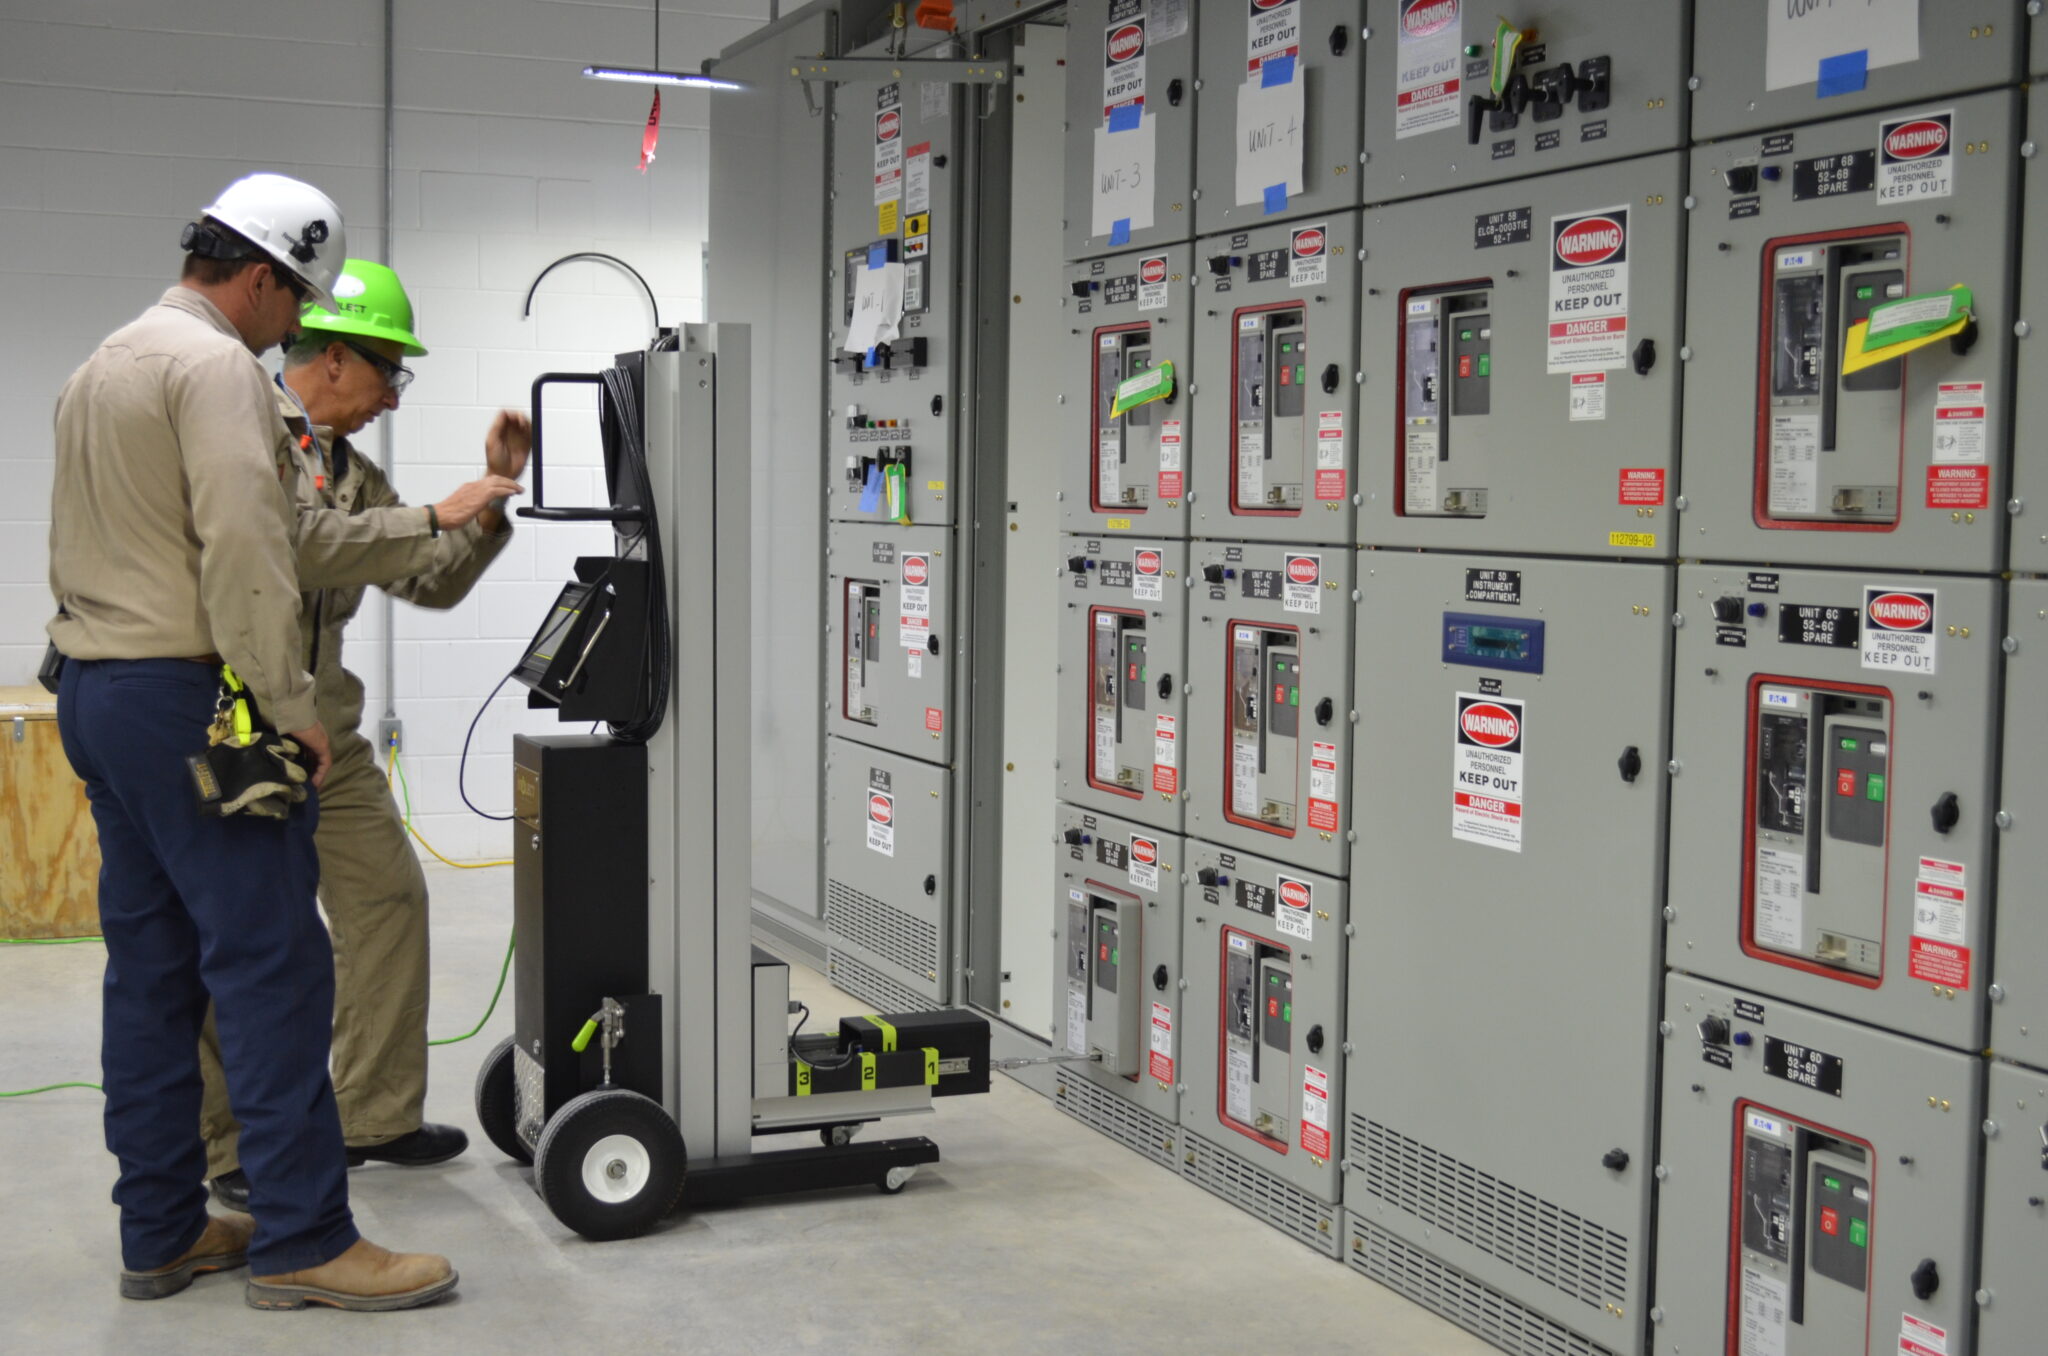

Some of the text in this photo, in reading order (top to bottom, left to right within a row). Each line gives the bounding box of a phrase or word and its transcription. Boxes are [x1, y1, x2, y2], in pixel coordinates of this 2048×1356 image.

[1405, 3, 1457, 31] WARNING
[1260, 19, 1288, 33] PERSONNEL
[1110, 31, 1141, 57] WARNING
[1252, 26, 1297, 50] KEEP OUT
[1402, 58, 1456, 82] KEEP OUT
[1107, 79, 1142, 97] KEEP OUT
[1411, 84, 1445, 103] DANGER
[1889, 129, 1943, 151] WARNING
[1813, 155, 1853, 171] UNIT 6B
[1887, 159, 1942, 175] UNAUTHORIZED
[1817, 169, 1849, 182] 52-6B
[1893, 171, 1935, 184] PERSONNEL
[1817, 182, 1848, 195] SPARE
[1880, 179, 1947, 199] KEEP OUT
[1489, 213, 1504, 224] UNIT
[1295, 236, 1322, 250] WARNING
[1493, 233, 1511, 244] 52-T
[1560, 229, 1618, 255] WARNING
[1257, 253, 1269, 262] UNIT
[1142, 266, 1165, 277] WARNING
[1259, 270, 1276, 279] SPARE
[1291, 271, 1325, 283] KEEP OUT
[1562, 269, 1615, 284] UNAUTHORIZED
[1567, 282, 1608, 295] PERSONNEL
[1140, 296, 1167, 306] KEEP OUT
[1555, 293, 1622, 312] KEEP OUT
[1566, 320, 1608, 335] DANGER
[1627, 472, 1656, 480] WARNING
[1938, 469, 1976, 478] WARNING
[1610, 533, 1654, 546] 112799-02
[1138, 558, 1160, 568] WARNING
[1252, 571, 1263, 579] UNIT
[1289, 565, 1316, 577] WARNING
[1480, 571, 1495, 580] UNIT
[1135, 588, 1161, 598] KEEP OUT
[1254, 588, 1270, 597] SPARE
[1473, 581, 1513, 592] INSTRUMENT
[1469, 590, 1516, 602] COMPARTMENT
[903, 602, 927, 612] KEEP OUT
[1285, 599, 1318, 609] KEEP OUT
[1799, 608, 1839, 620] UNIT 6C
[1873, 602, 1927, 621] WARNING
[1803, 620, 1834, 632] 52-6C
[1802, 632, 1833, 644] SPARE
[1872, 632, 1926, 644] UNAUTHORIZED
[1877, 642, 1919, 653] PERSONNEL
[1864, 651, 1931, 668] KEEP OUT
[1464, 713, 1515, 738] WARNING
[1466, 750, 1512, 765] UNAUTHORIZED
[1470, 761, 1506, 775] PERSONNEL
[1460, 771, 1517, 792] KEEP OUT
[1469, 796, 1505, 814] DANGER
[1132, 845, 1155, 858] WARNING
[1130, 874, 1157, 888] KEEP OUT
[1245, 883, 1256, 892] UNIT
[1281, 886, 1308, 904] WARNING
[1247, 900, 1263, 912] SPARE
[1278, 919, 1310, 936] KEEP OUT
[1920, 942, 1958, 959] WARNING
[1784, 1043, 1822, 1063] UNIT 6D
[928, 1062, 935, 1075] 1
[1787, 1057, 1817, 1074] 52-6D
[799, 1072, 810, 1085] 3
[864, 1066, 874, 1080] 2
[1787, 1068, 1817, 1087] SPARE
